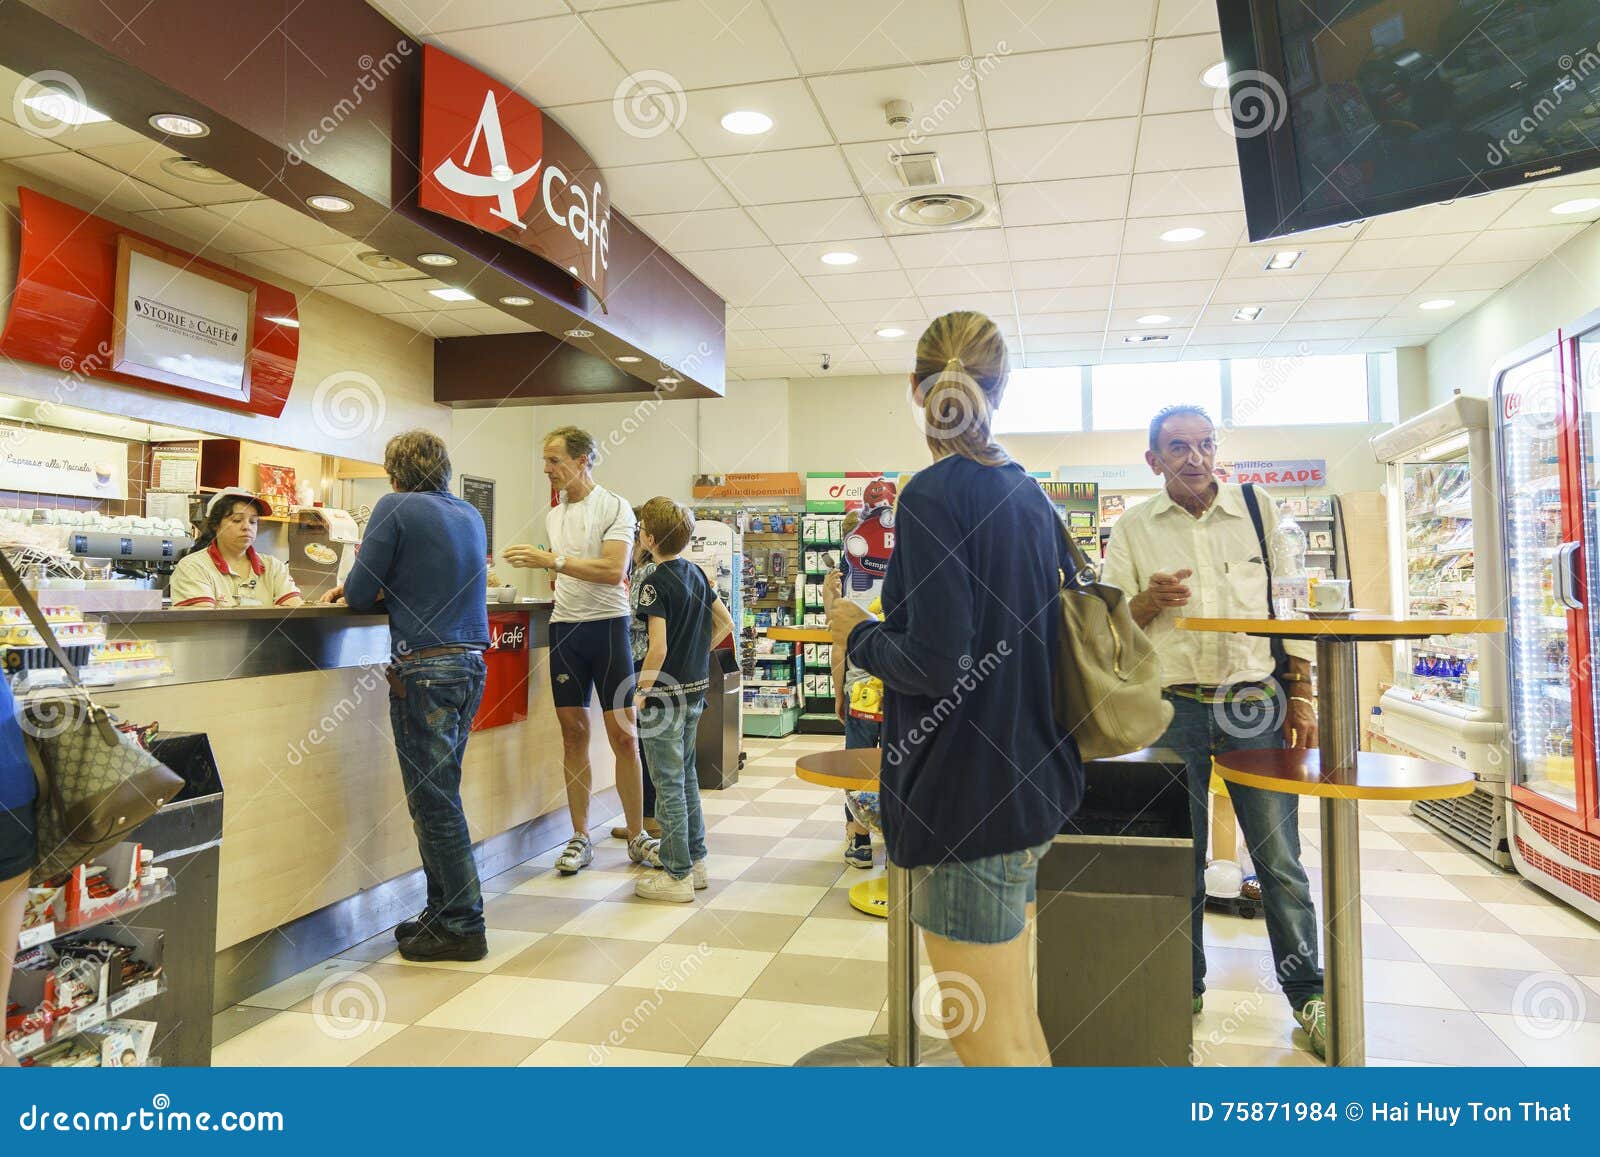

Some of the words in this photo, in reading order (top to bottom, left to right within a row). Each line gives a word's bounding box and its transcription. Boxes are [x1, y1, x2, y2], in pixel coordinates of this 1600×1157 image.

[542, 166, 611, 281] café
[143, 302, 186, 327] STORIE
[45, 458, 61, 470] alla
[1237, 468, 1322, 484] PARADE
[502, 626, 526, 649] café
